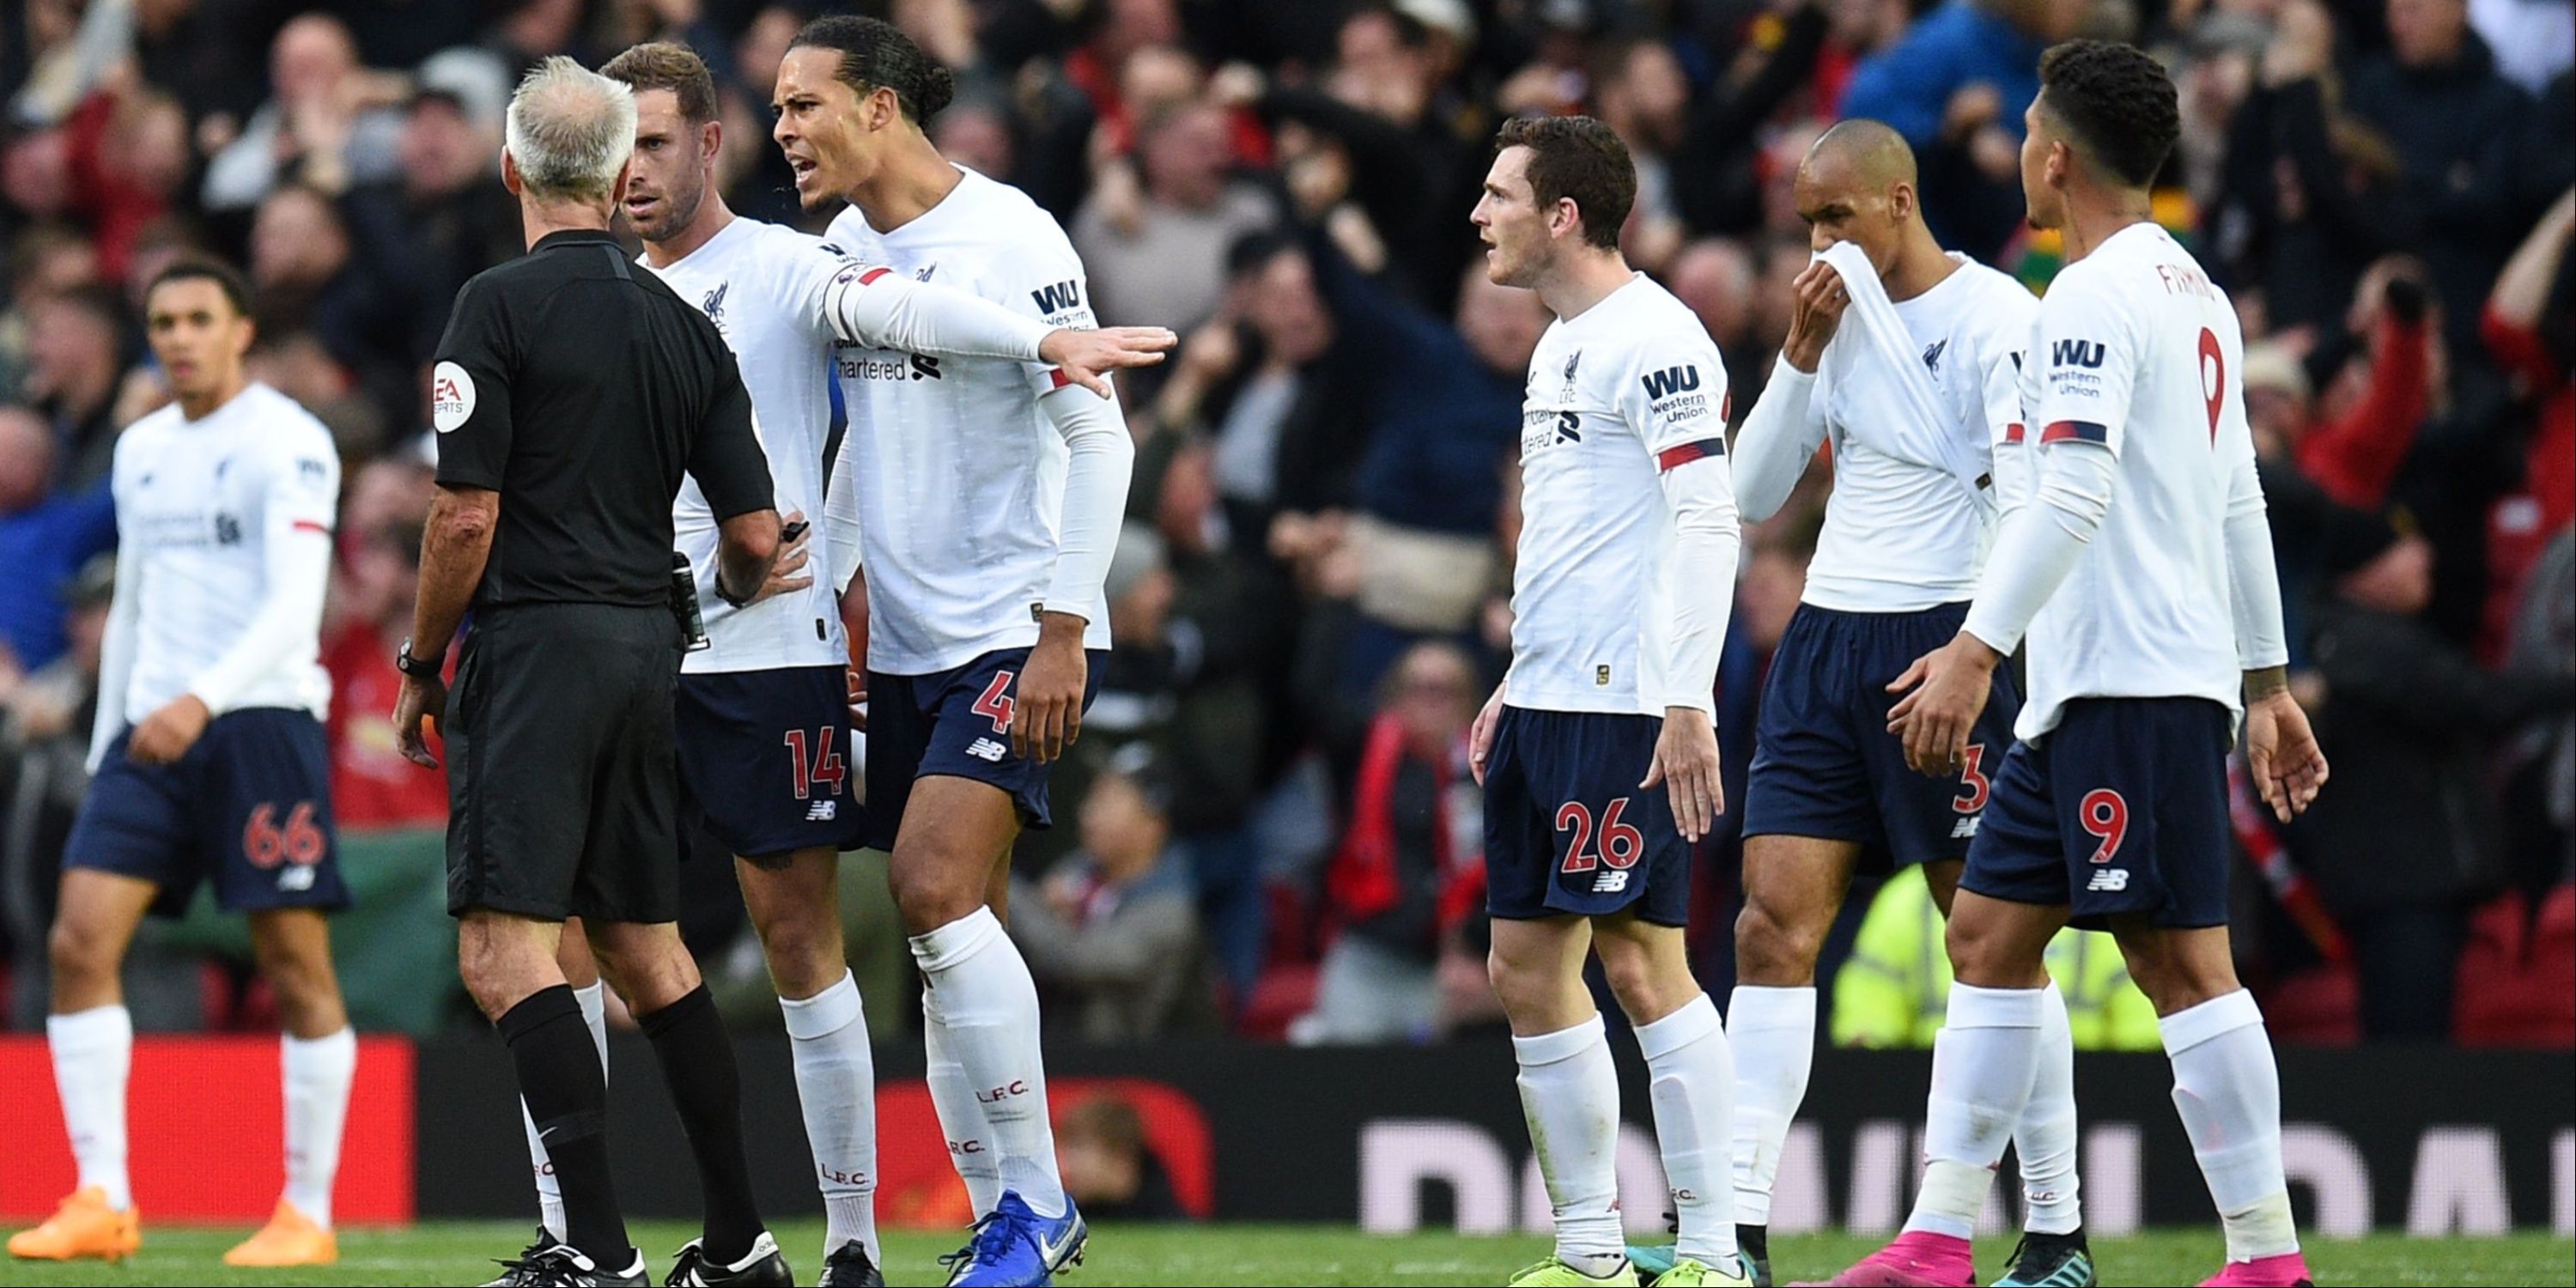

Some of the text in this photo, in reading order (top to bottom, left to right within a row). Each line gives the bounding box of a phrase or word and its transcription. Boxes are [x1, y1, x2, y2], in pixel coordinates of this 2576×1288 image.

[1030, 279, 1079, 315] WU
[1040, 310, 1088, 325] Wesrn
[835, 356, 906, 380] hartered
[2052, 338, 2105, 368] WU
[435, 379, 462, 402] EA
[1641, 364, 1700, 401] WU
[2198, 326, 2225, 453] 9
[1649, 394, 1706, 415] Western
[1667, 407, 1708, 423] Union
[971, 670, 1015, 735] 4
[784, 726, 846, 799] 14
[1949, 743, 1990, 814] 3
[243, 802, 325, 869] 66
[1555, 797, 1643, 872] 26
[1949, 817, 1981, 838] N
[2079, 788, 2129, 863] 9
